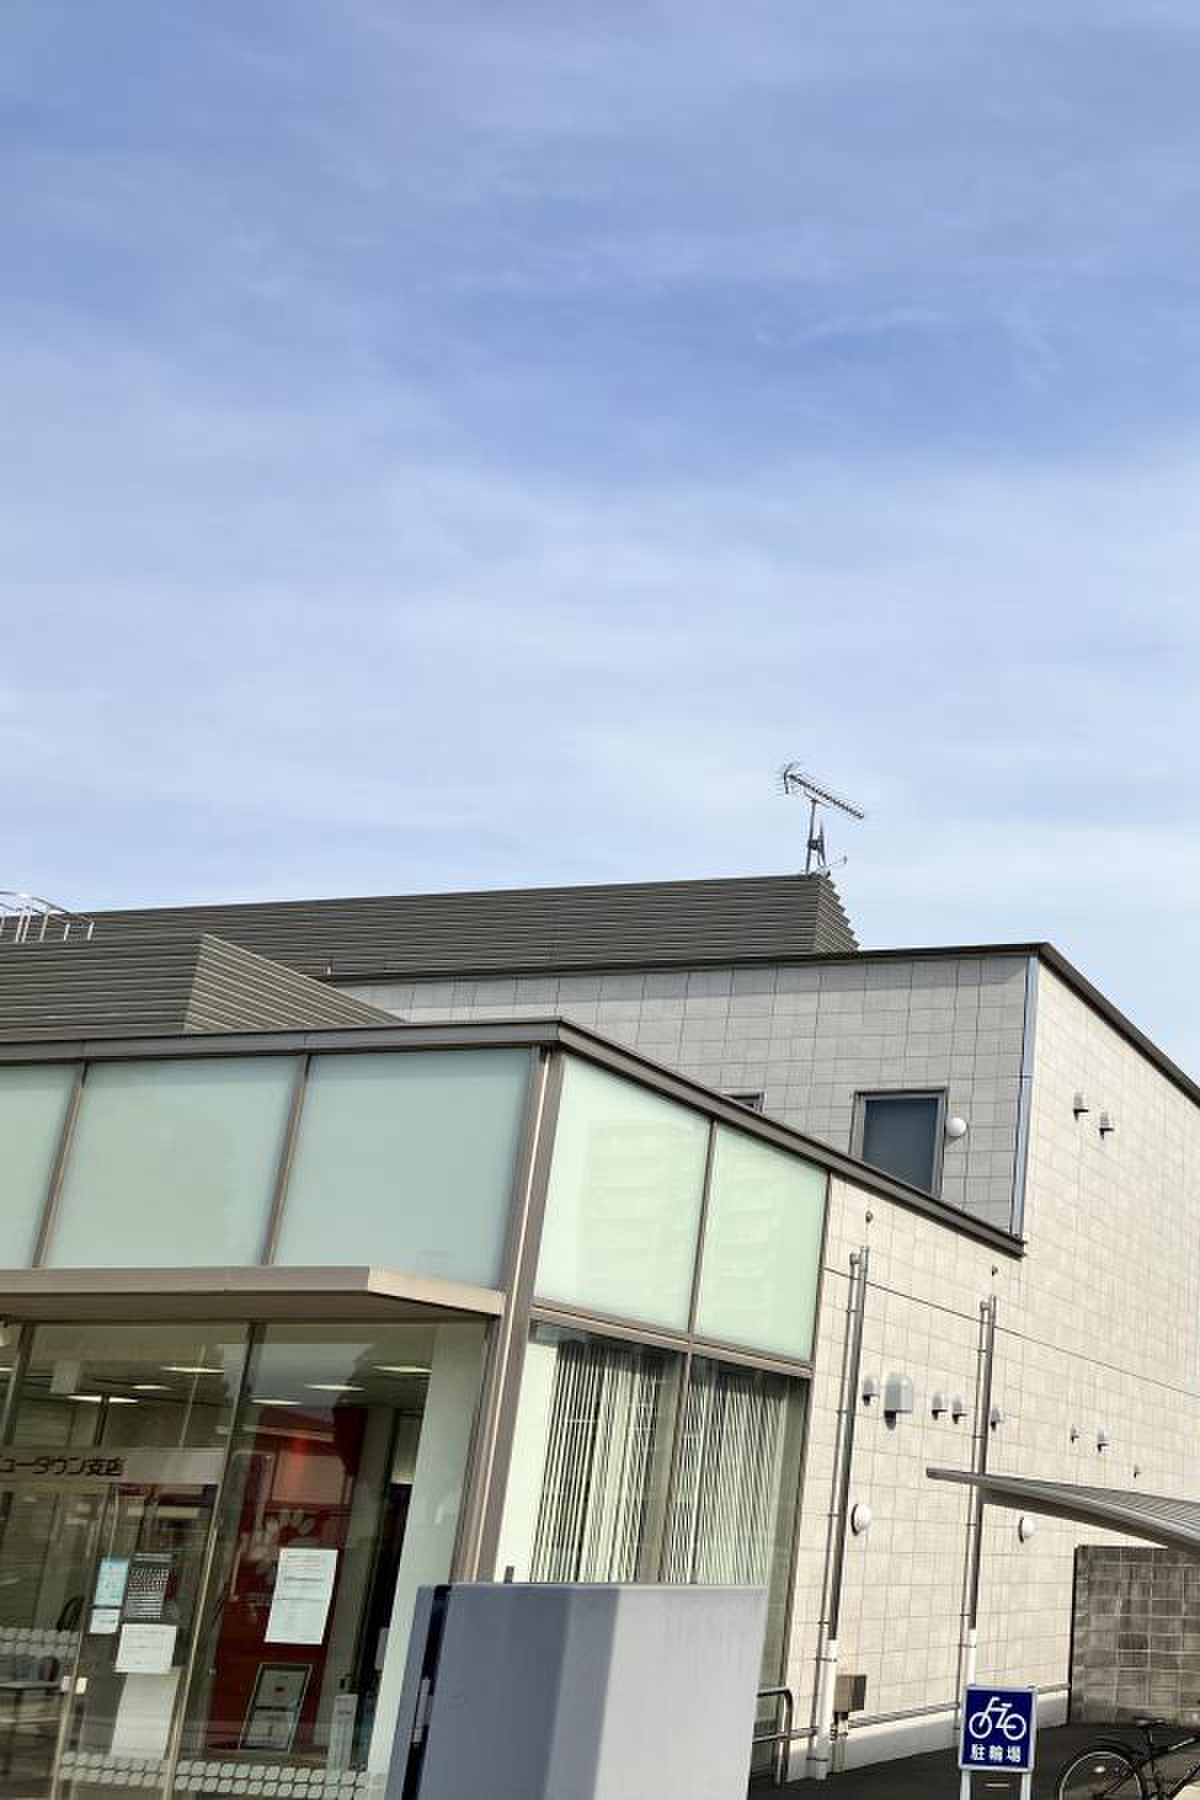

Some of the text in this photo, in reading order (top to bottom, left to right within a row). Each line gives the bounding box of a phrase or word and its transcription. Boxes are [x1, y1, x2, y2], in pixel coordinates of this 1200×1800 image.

[0, 1455, 125, 1476] ュータウン支店
[970, 1743, 1021, 1763] 駐輪場
